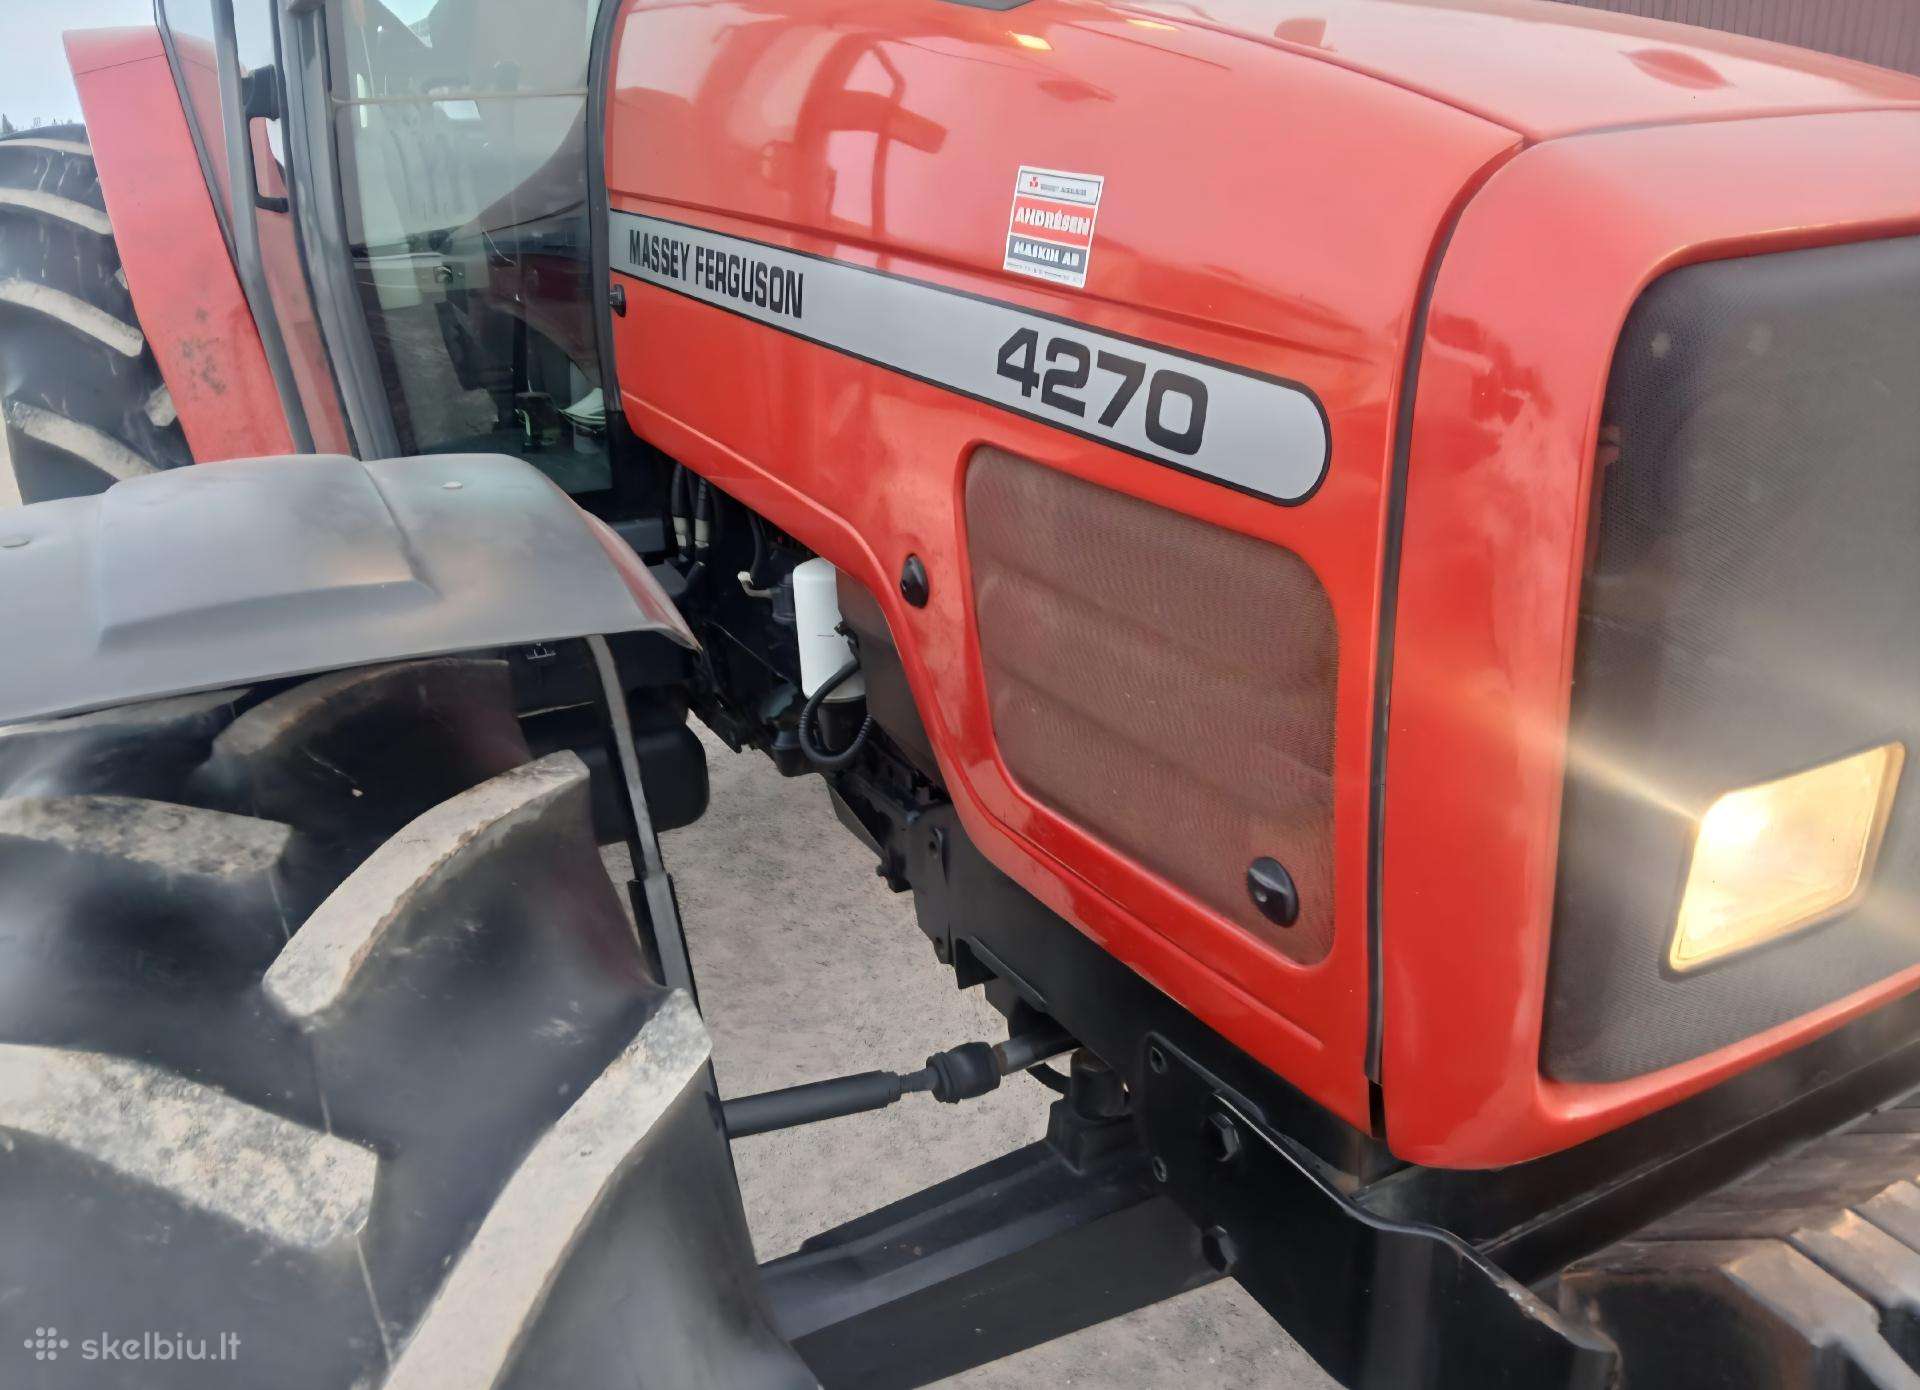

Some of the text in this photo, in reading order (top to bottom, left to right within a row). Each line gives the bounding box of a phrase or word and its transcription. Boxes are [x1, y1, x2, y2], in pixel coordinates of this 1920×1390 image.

[629, 229, 804, 319] MASSEY FERGUSON
[996, 327, 1208, 456] 4270
